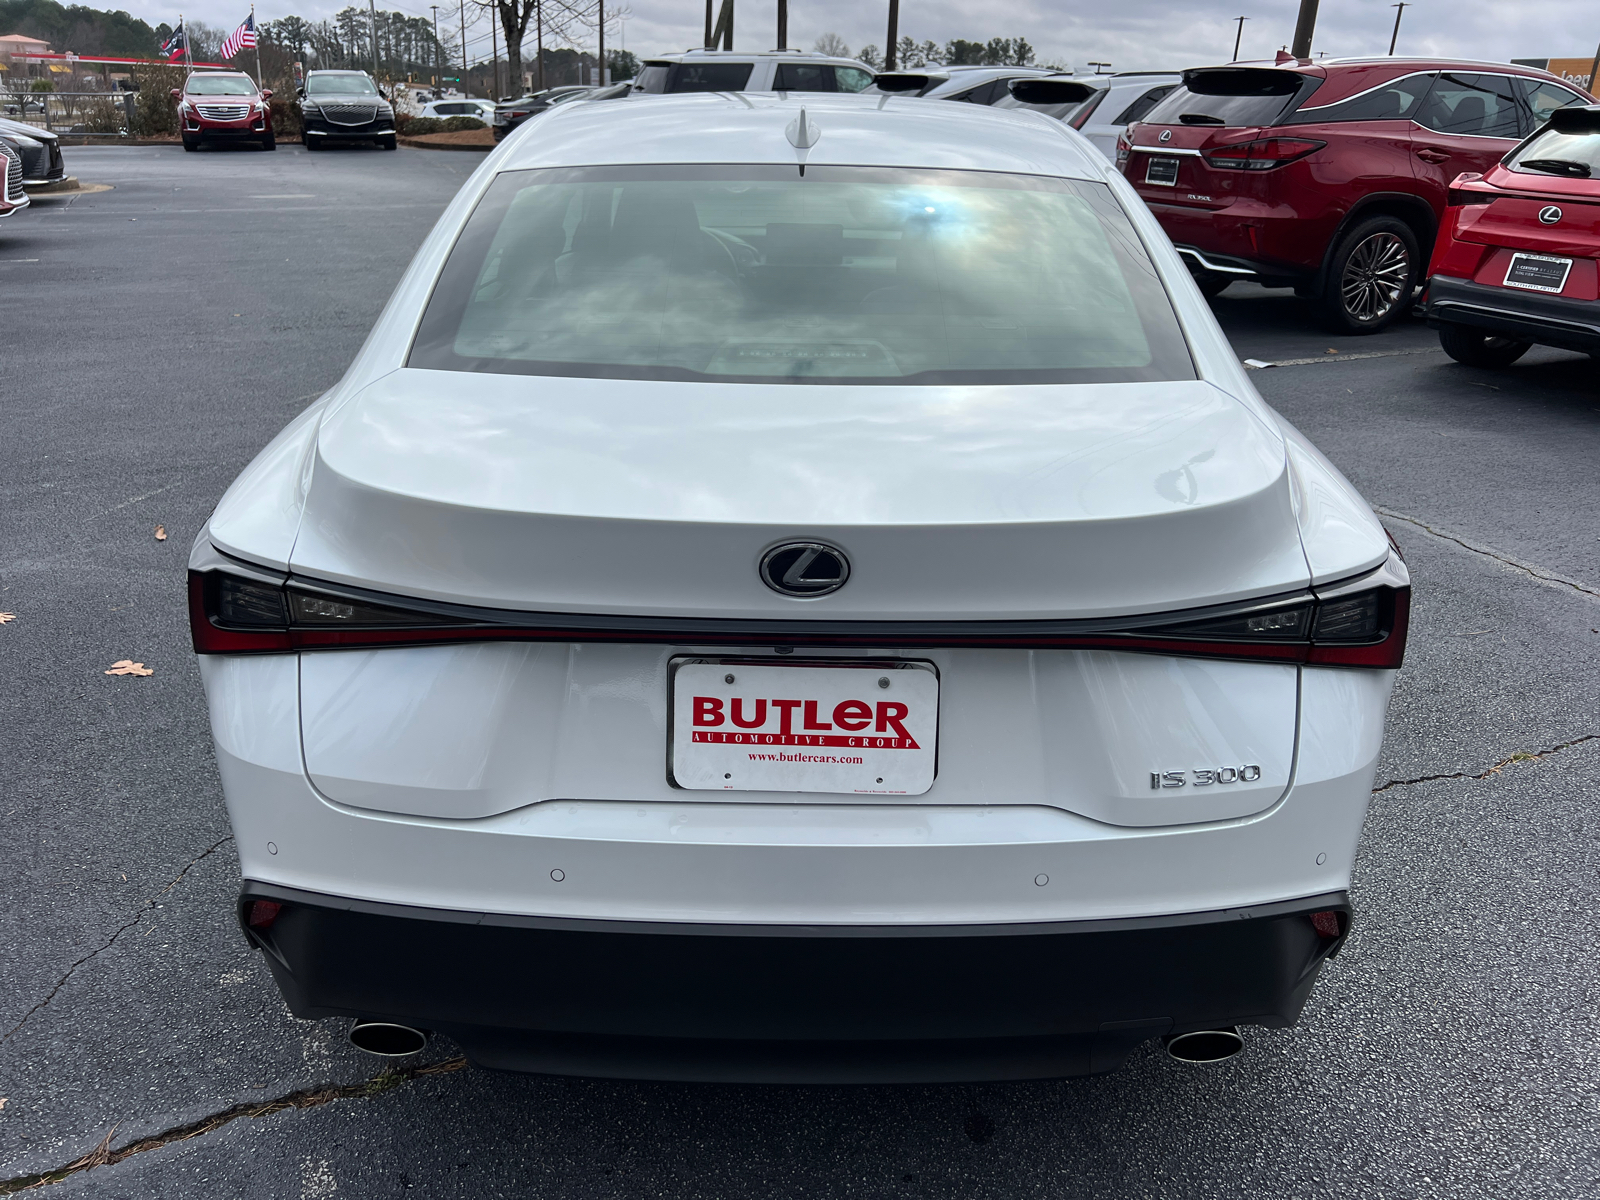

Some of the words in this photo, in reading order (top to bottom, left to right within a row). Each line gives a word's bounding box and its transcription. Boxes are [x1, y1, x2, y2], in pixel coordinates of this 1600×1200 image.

[1561, 70, 1590, 88] Jeep
[693, 732, 826, 746] AUTOMOTIVE
[848, 737, 912, 748] GROUP
[747, 752, 863, 764] www.butlercars.com
[1150, 771, 1186, 789] IS
[1192, 764, 1260, 786] 300
